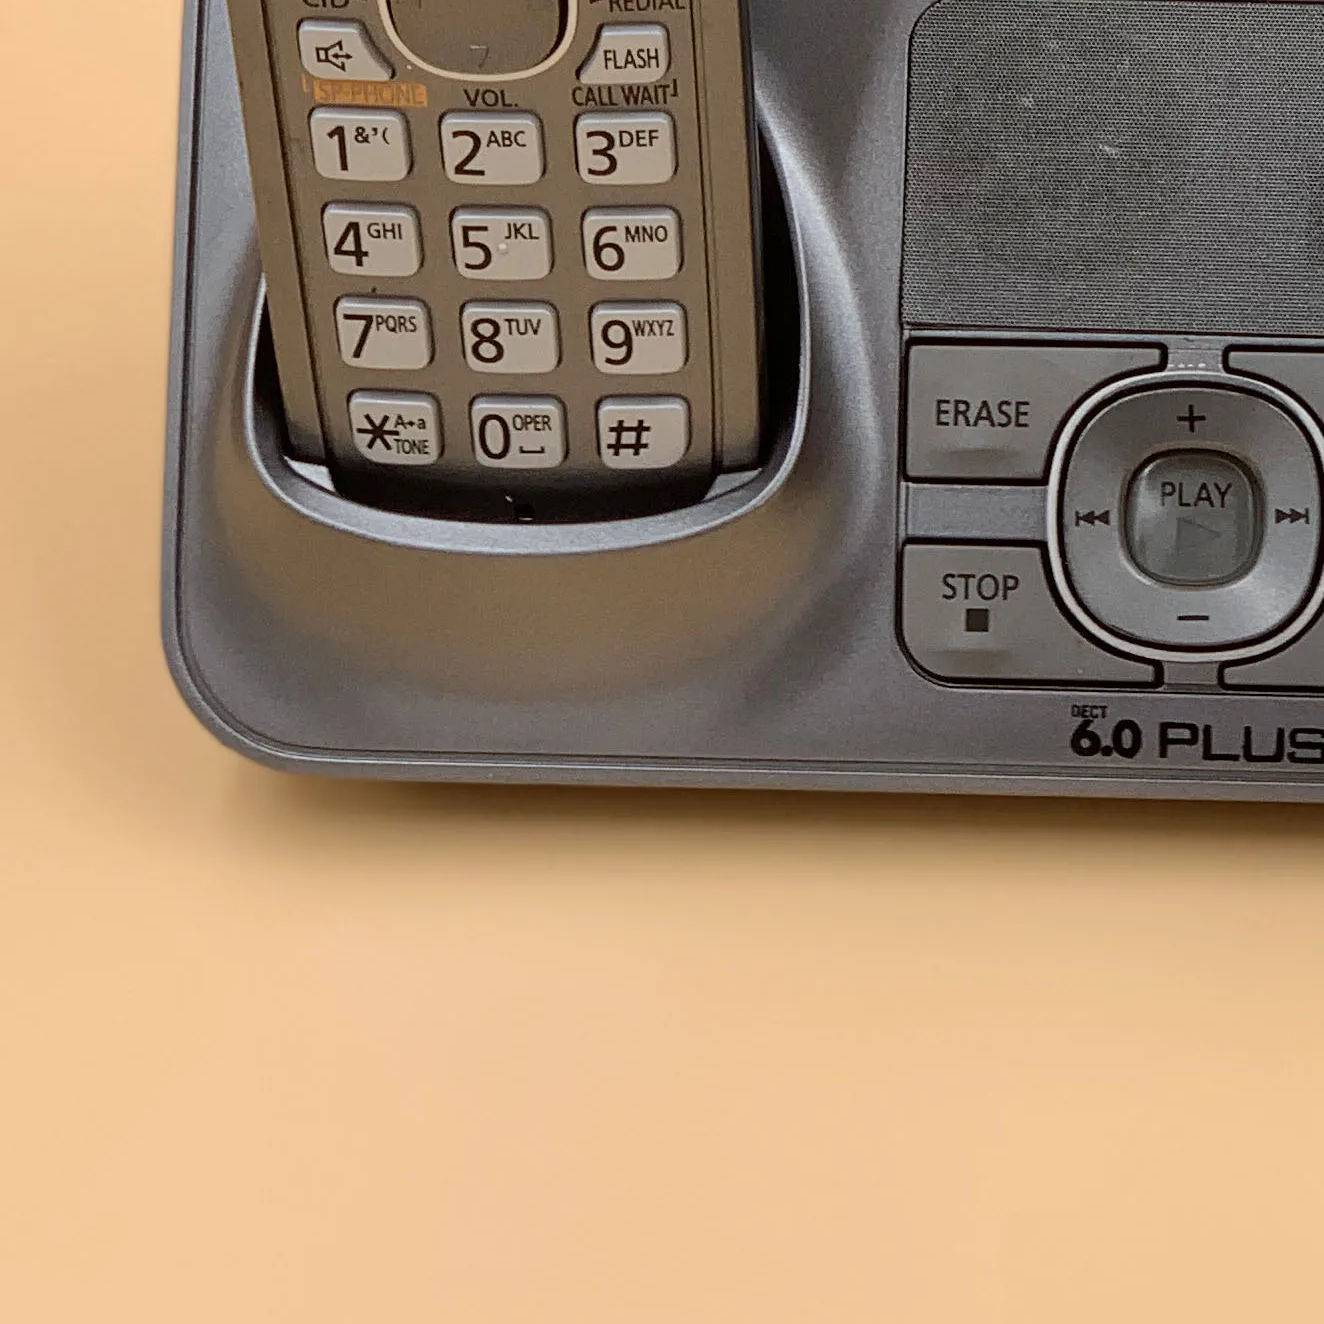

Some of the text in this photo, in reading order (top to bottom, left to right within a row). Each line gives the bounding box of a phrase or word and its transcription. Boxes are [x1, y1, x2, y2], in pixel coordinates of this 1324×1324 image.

[603, 47, 660, 70] FLASH
[463, 87, 519, 108] VOL.
[571, 85, 669, 107] CALL WAIT
[326, 125, 350, 172] 1
[451, 129, 527, 176] 2 ABC
[585, 129, 660, 176] 3 DEF
[332, 221, 403, 267] 4 GHI
[462, 223, 540, 270] 5 JKL
[592, 224, 668, 272] 6 MNO
[342, 313, 418, 359] 7 PQRS
[469, 317, 542, 363] 8 TUV
[600, 319, 675, 365] 9 WXYZ
[512, 414, 552, 432] OPER
[934, 399, 1030, 429] ERASE
[393, 438, 430, 455] TONE
[1160, 481, 1232, 509] PLAY
[941, 573, 1020, 602] STOP
[1070, 704, 1109, 719] DECT
[1070, 719, 1143, 759] 6.0
